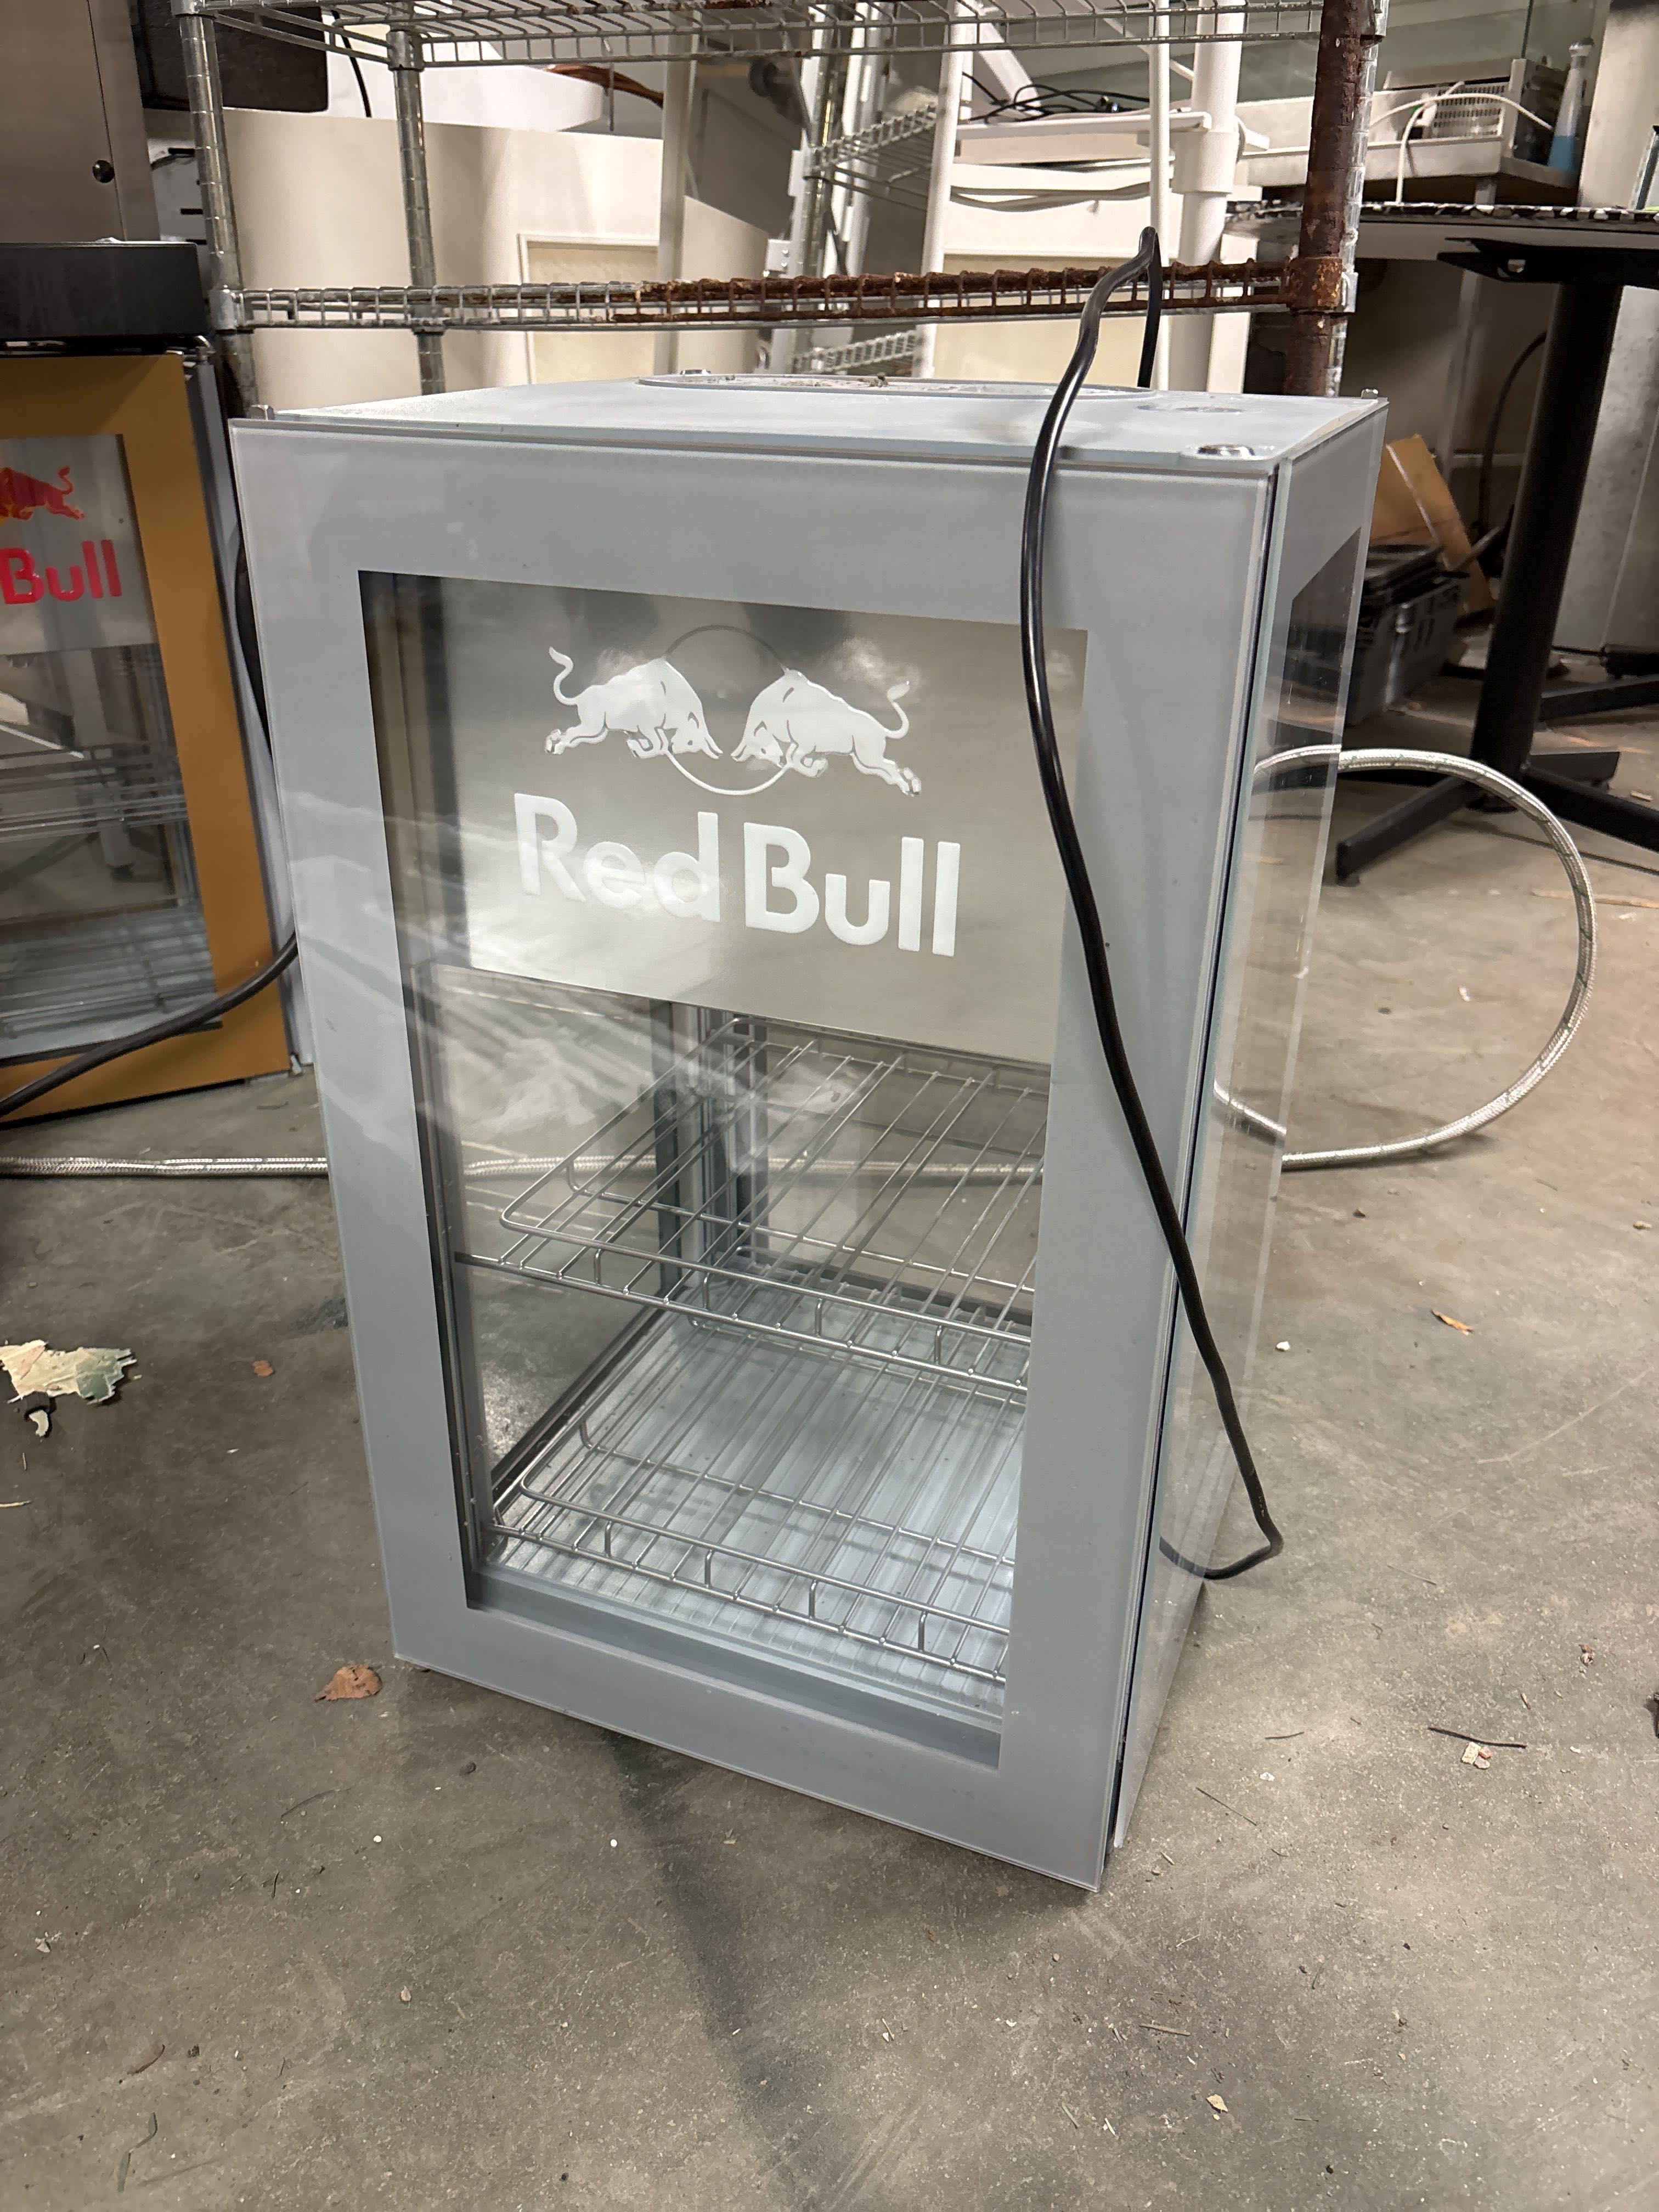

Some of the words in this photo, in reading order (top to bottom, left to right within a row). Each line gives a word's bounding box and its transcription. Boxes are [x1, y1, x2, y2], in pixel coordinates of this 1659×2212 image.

[0, 540, 122, 604] Bull
[514, 793, 720, 922] Red
[744, 822, 961, 957] Bull
